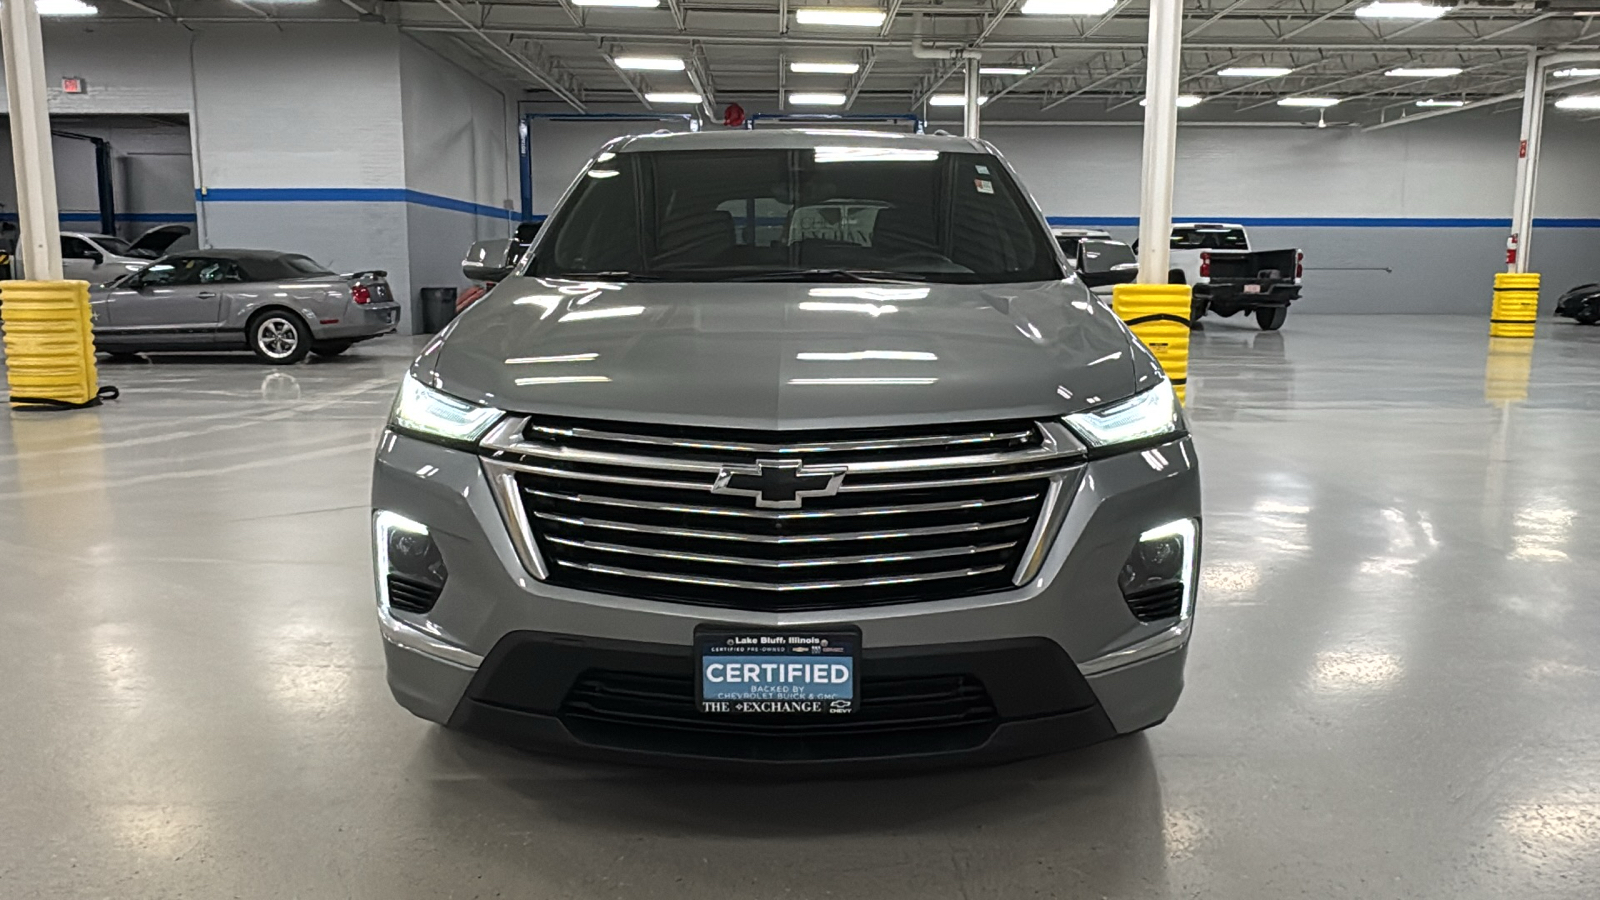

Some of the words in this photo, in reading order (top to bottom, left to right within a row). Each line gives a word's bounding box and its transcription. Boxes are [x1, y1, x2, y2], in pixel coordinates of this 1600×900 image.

[735, 636, 758, 645] Lake
[760, 636, 786, 645] Bluff,
[788, 636, 820, 645] Illinois
[706, 663, 849, 684] CERTIFIED
[751, 685, 789, 693] BACKED
[792, 685, 805, 693] BY
[717, 692, 774, 700] CHEVROLET
[777, 692, 806, 700] BUICK
[702, 701, 730, 713] THE
[742, 701, 822, 713] EXCHANGE
